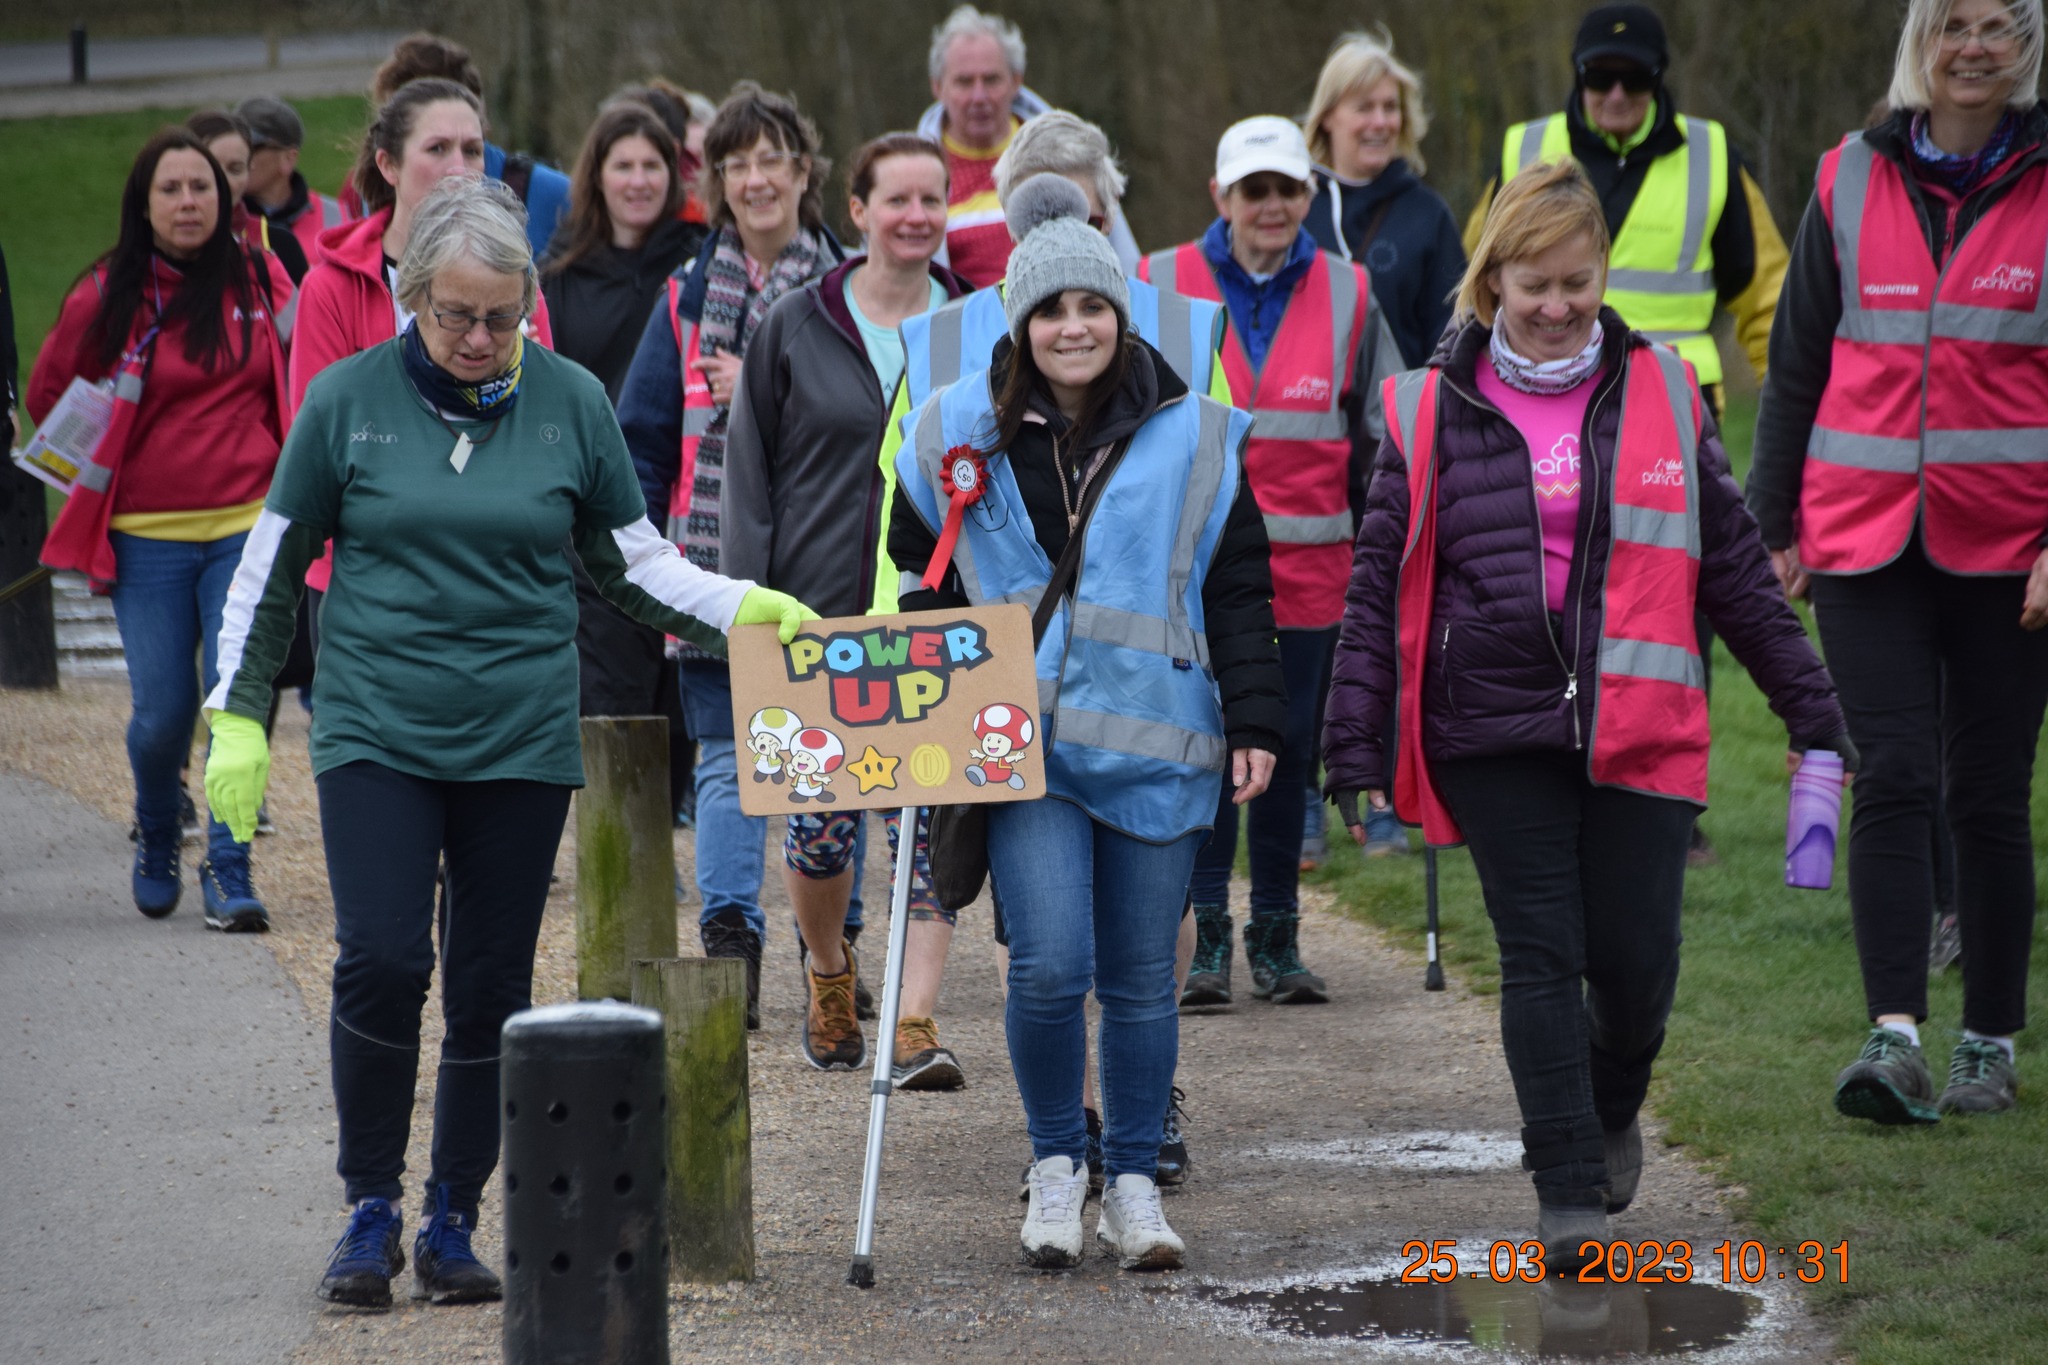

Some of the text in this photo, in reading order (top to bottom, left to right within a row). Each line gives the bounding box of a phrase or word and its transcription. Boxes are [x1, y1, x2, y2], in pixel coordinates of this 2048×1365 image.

[1863, 283, 1919, 296] VOLUNTEER
[1971, 269, 2034, 294] parkrun
[350, 424, 398, 444] parkrun
[961, 473, 972, 483] 50
[1641, 465, 1685, 486] parkru
[786, 622, 990, 679] POWER
[832, 670, 947, 725] UP
